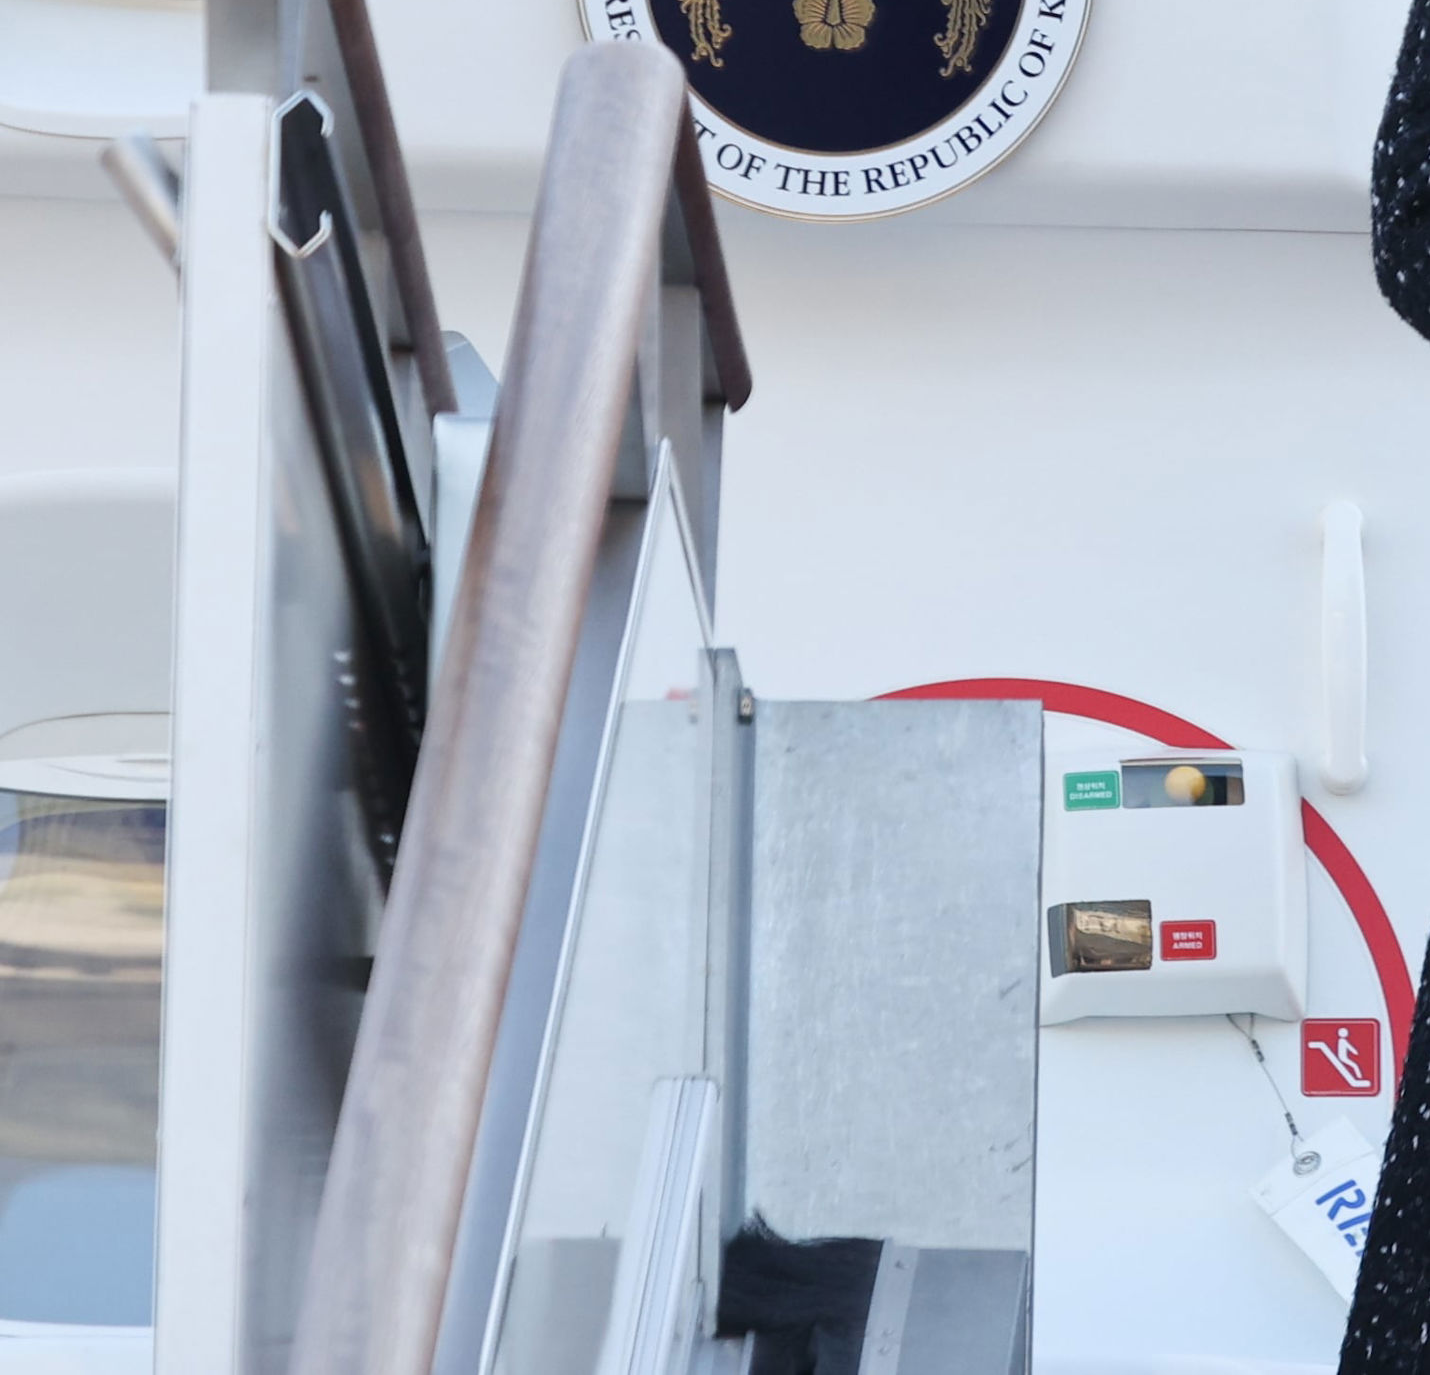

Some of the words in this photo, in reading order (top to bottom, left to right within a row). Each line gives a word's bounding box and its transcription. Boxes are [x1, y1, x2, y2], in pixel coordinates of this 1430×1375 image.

[717, 143, 767, 180] OF
[774, 163, 850, 196] THE
[861, 79, 1028, 194] REPUBLIC
[1018, 28, 1056, 78] OF
[1172, 941, 1203, 950] ARMED
